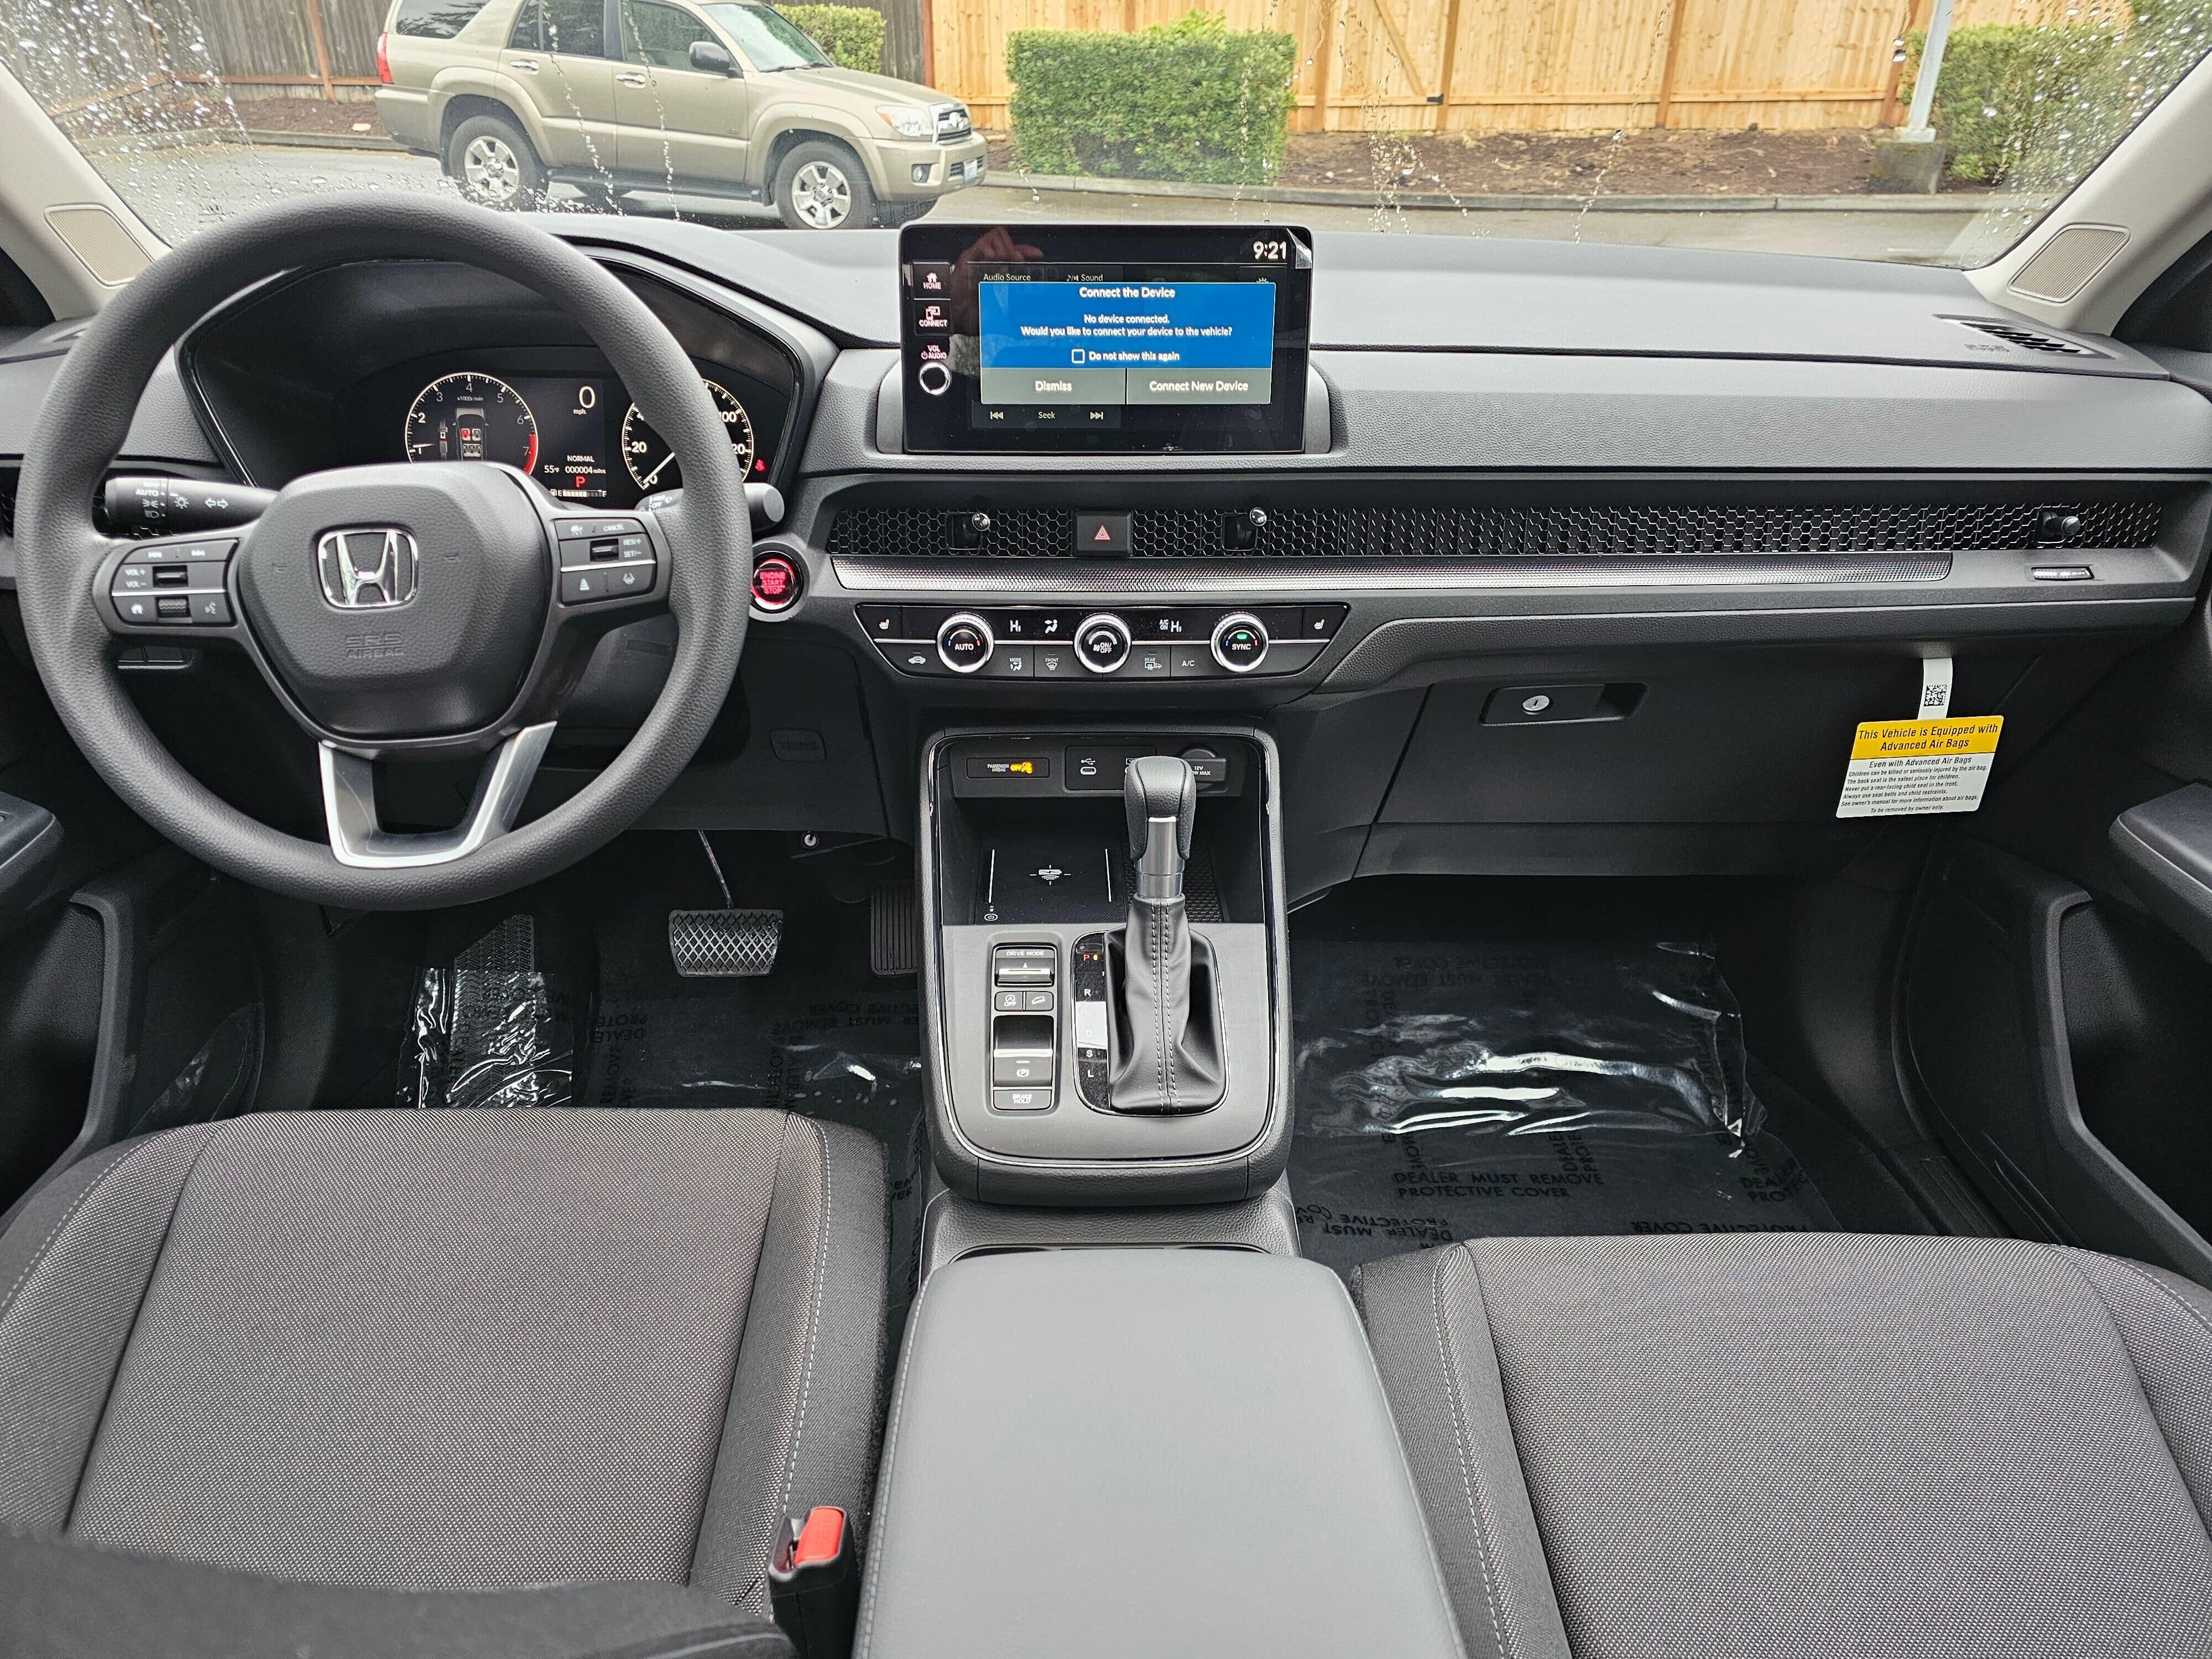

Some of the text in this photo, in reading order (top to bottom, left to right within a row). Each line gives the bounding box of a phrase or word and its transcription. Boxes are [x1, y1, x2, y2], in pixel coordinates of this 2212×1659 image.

[1253, 241, 1287, 259] 9:21
[1079, 286, 1176, 298] Connect the Device
[1084, 314, 1170, 324] No device connected.
[1020, 326, 1233, 337] Would you like to connect your device to the vehicle?
[1088, 351, 1180, 362] Do not show this again
[466, 383, 473, 392] 4
[1035, 380, 1072, 391] Dismiss
[1149, 380, 1249, 391] Connect New Device
[436, 392, 443, 402] 3
[497, 393, 504, 403] 5
[579, 385, 595, 409] 0
[418, 413, 426, 423] 2
[517, 415, 524, 425] 6
[1038, 411, 1056, 420] Seek
[523, 446, 529, 456] 7
[632, 441, 647, 453] 20
[565, 466, 593, 474] 000004
[575, 476, 586, 488] P
[135, 488, 159, 497] AUTO
[760, 571, 785, 580] ENGINE
[1859, 724, 1998, 739] This Vehicle is Equipped with
[1880, 738, 1969, 751] Advanced Air Bags
[1905, 758, 1940, 766] Advanced
[1088, 1070, 1094, 1078] L
[1393, 1172, 1604, 1186] DEALER MUST REMOVE
[1397, 1186, 1571, 1198] PROTECTIVE COVER
[1340, 1214, 1448, 1227] PROTECTIVE
[1322, 1222, 1453, 1241] DEALER MUST
[1630, 1220, 1693, 1234] COVER
